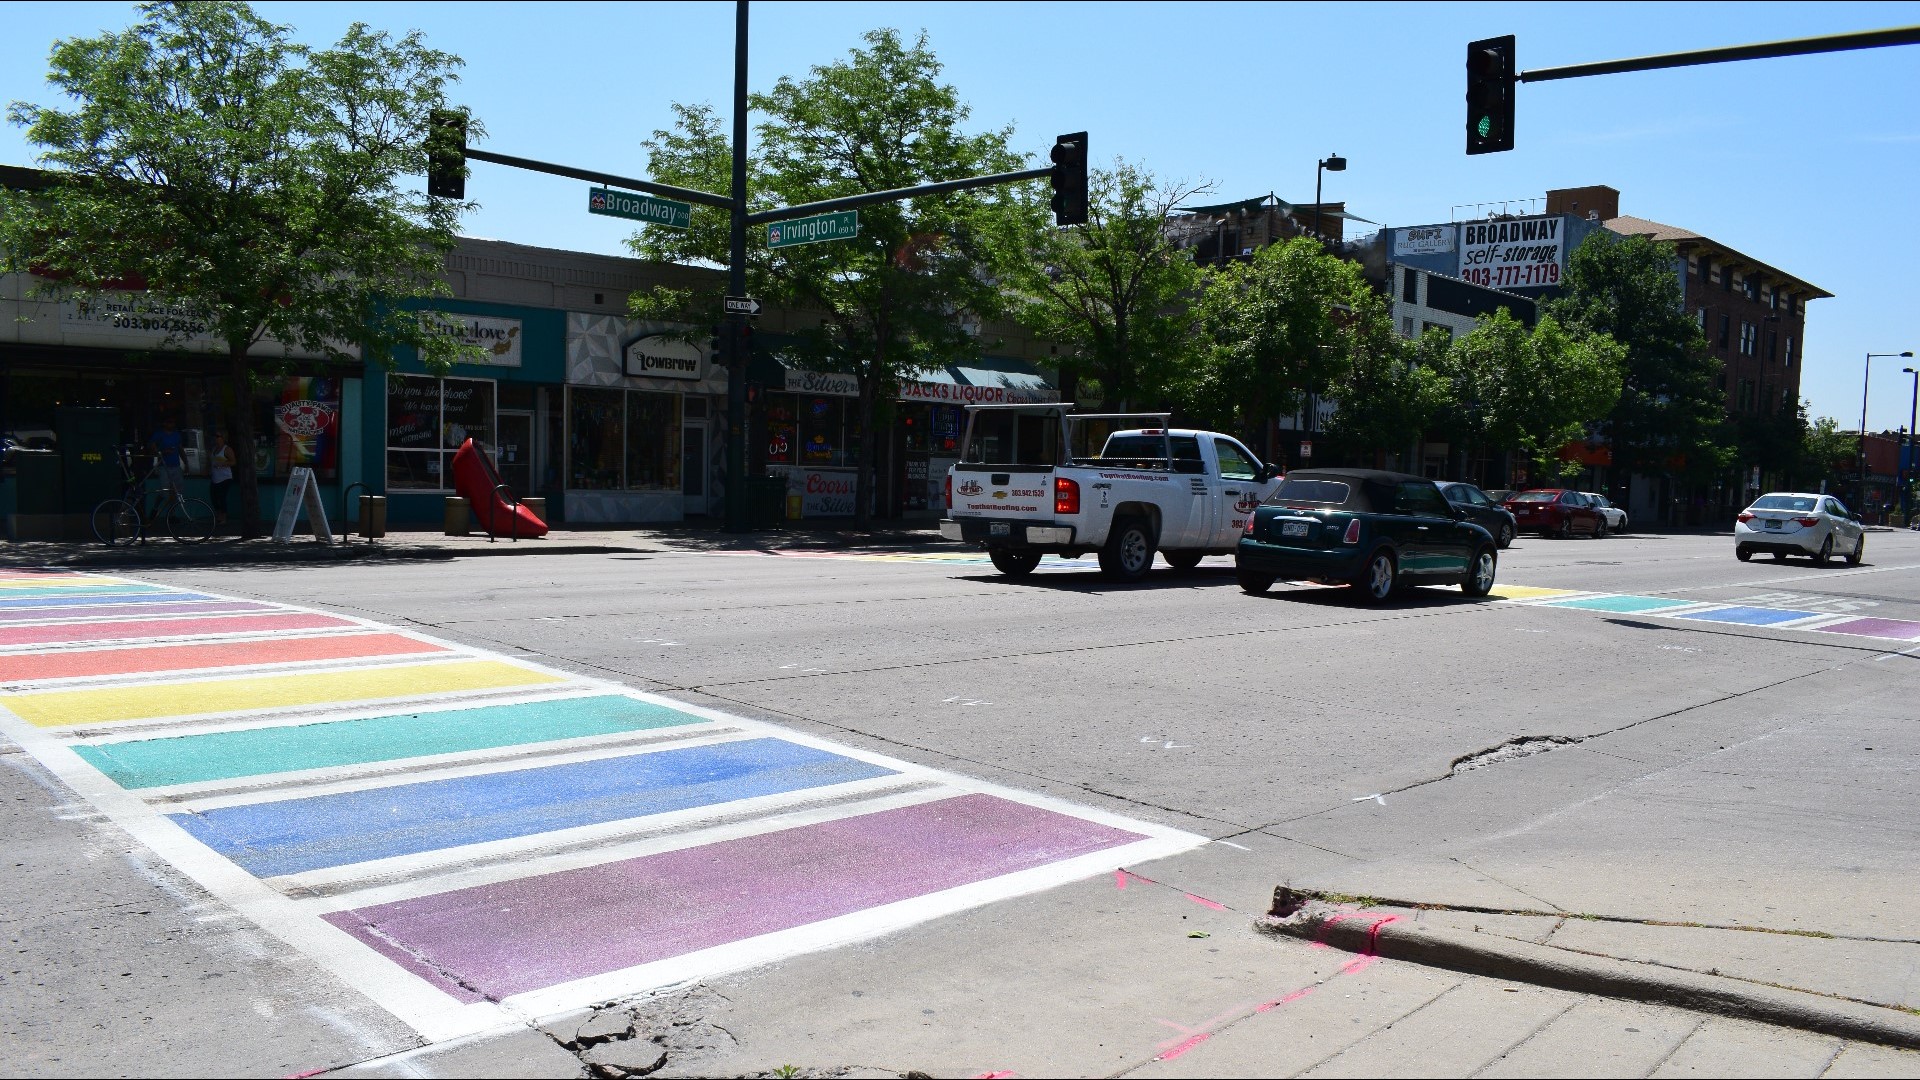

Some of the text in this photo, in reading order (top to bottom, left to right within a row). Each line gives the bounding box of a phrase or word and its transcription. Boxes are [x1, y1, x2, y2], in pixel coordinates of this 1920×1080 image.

[606, 193, 677, 224] Broadway
[783, 220, 837, 241] Irvington
[1465, 219, 1559, 245] BROADWAY
[1397, 238, 1452, 249] RUG GALLERY
[1464, 244, 1558, 266] self-storage
[1461, 262, 1559, 286] 303-777-7179
[106, 304, 136, 313] RETAIL
[137, 306, 165, 315] ACE
[167, 308, 185, 316] FOR
[728, 301, 751, 310] ONE WAY
[475, 321, 506, 341] love
[404, 387, 422, 398] you
[787, 378, 801, 388] THE
[803, 373, 849, 394] Silver
[906, 383, 949, 398] JACKS
[952, 385, 1004, 402] LIQUOR
[282, 400, 333, 414] QUALITY PAWS
[807, 475, 850, 494] Coors
[807, 496, 859, 514] THE Silve
[1237, 501, 1248, 509] TOP
